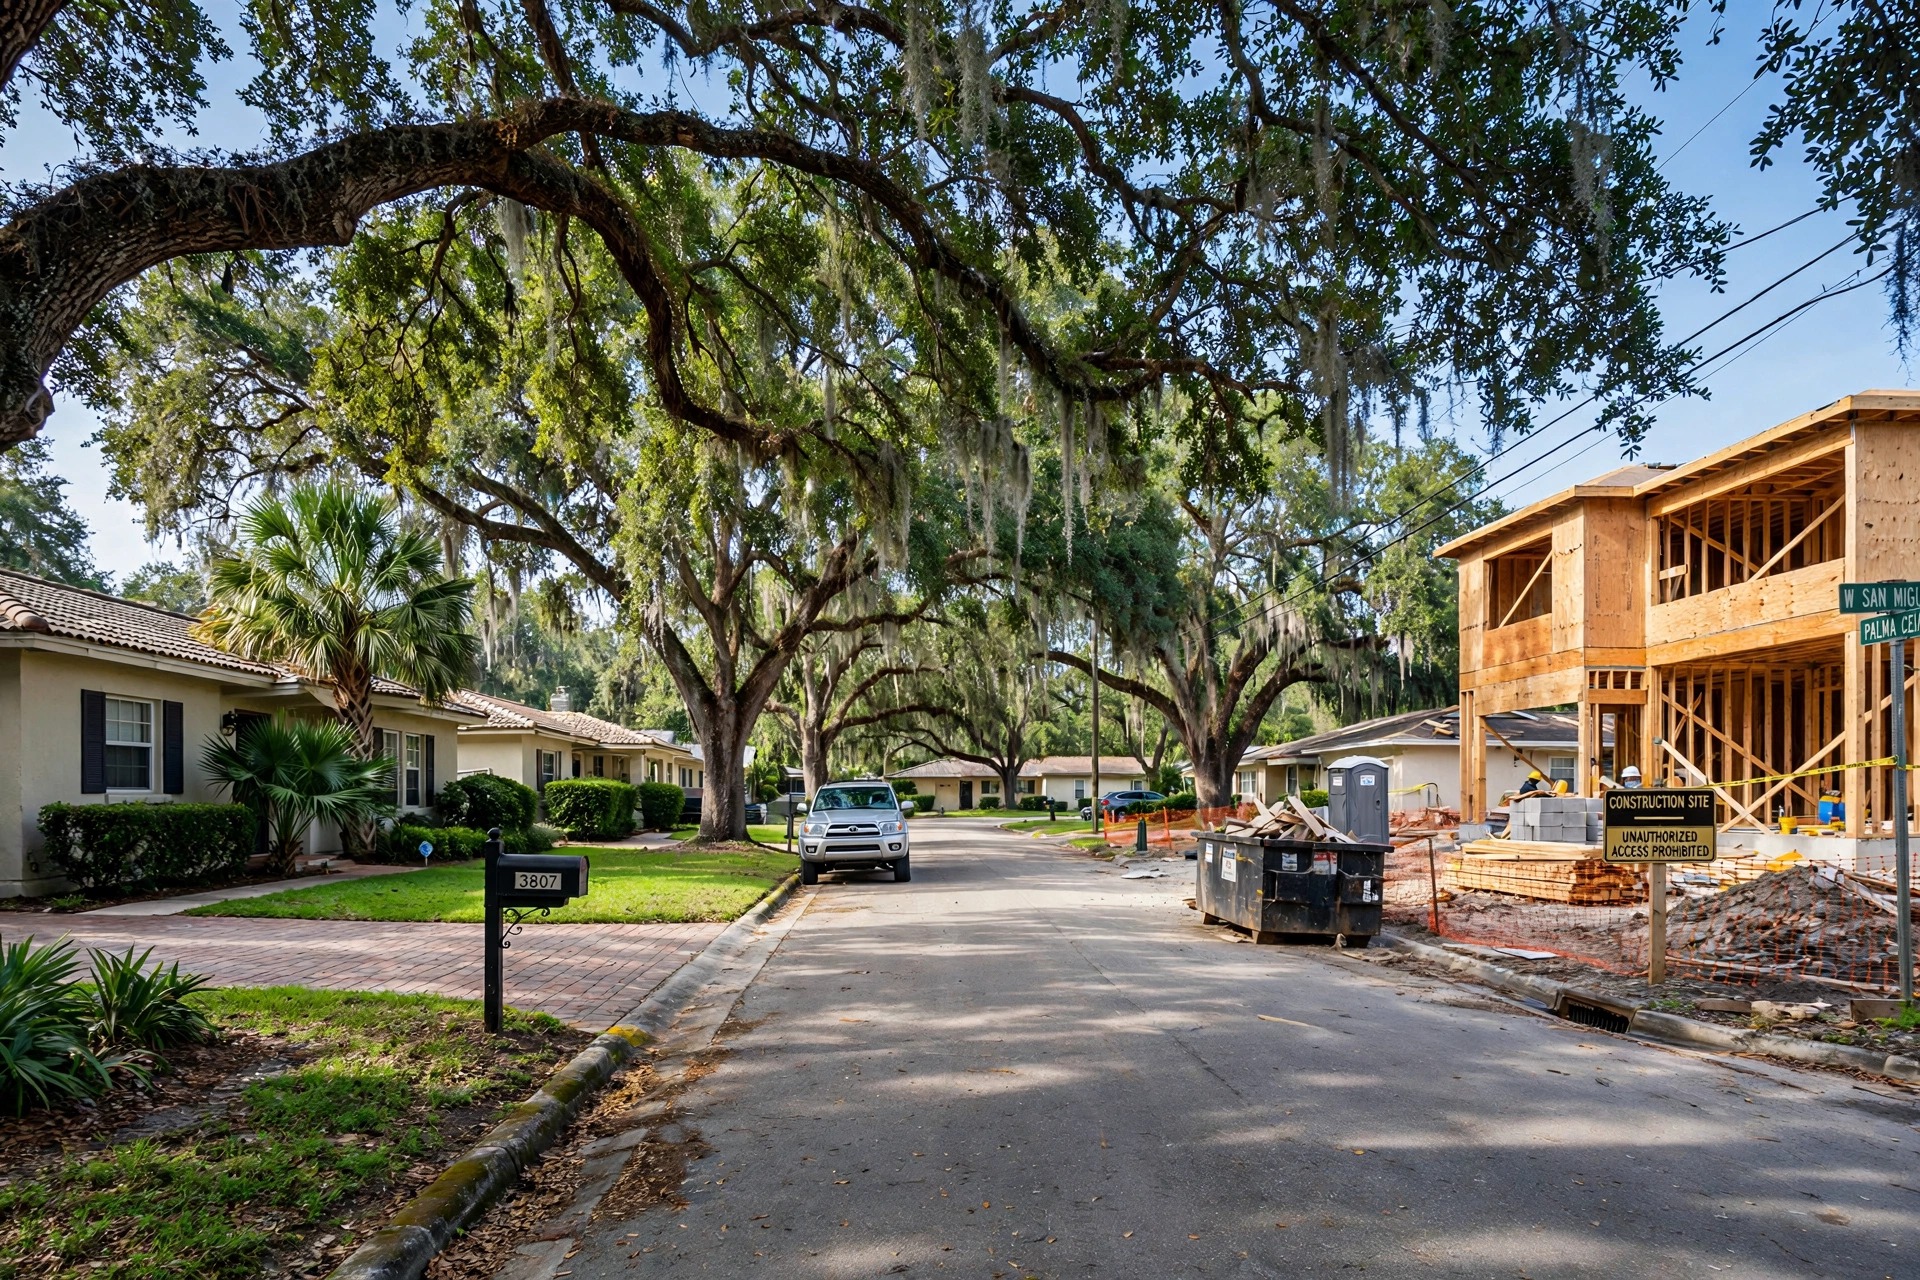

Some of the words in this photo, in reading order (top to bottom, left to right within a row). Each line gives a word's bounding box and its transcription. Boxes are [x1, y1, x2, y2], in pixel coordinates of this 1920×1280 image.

[1844, 588, 1854, 609] W
[1862, 587, 1887, 608] SAN
[1864, 618, 1897, 641] PALMA
[1609, 795, 1685, 809] CONSTRUCTION
[1688, 795, 1710, 808] SITE
[1622, 831, 1698, 843] UNAUTHORIZED
[1611, 845, 1649, 857] ACCESS
[1652, 845, 1710, 857] PROHIBITED
[519, 874, 558, 888] 3807
